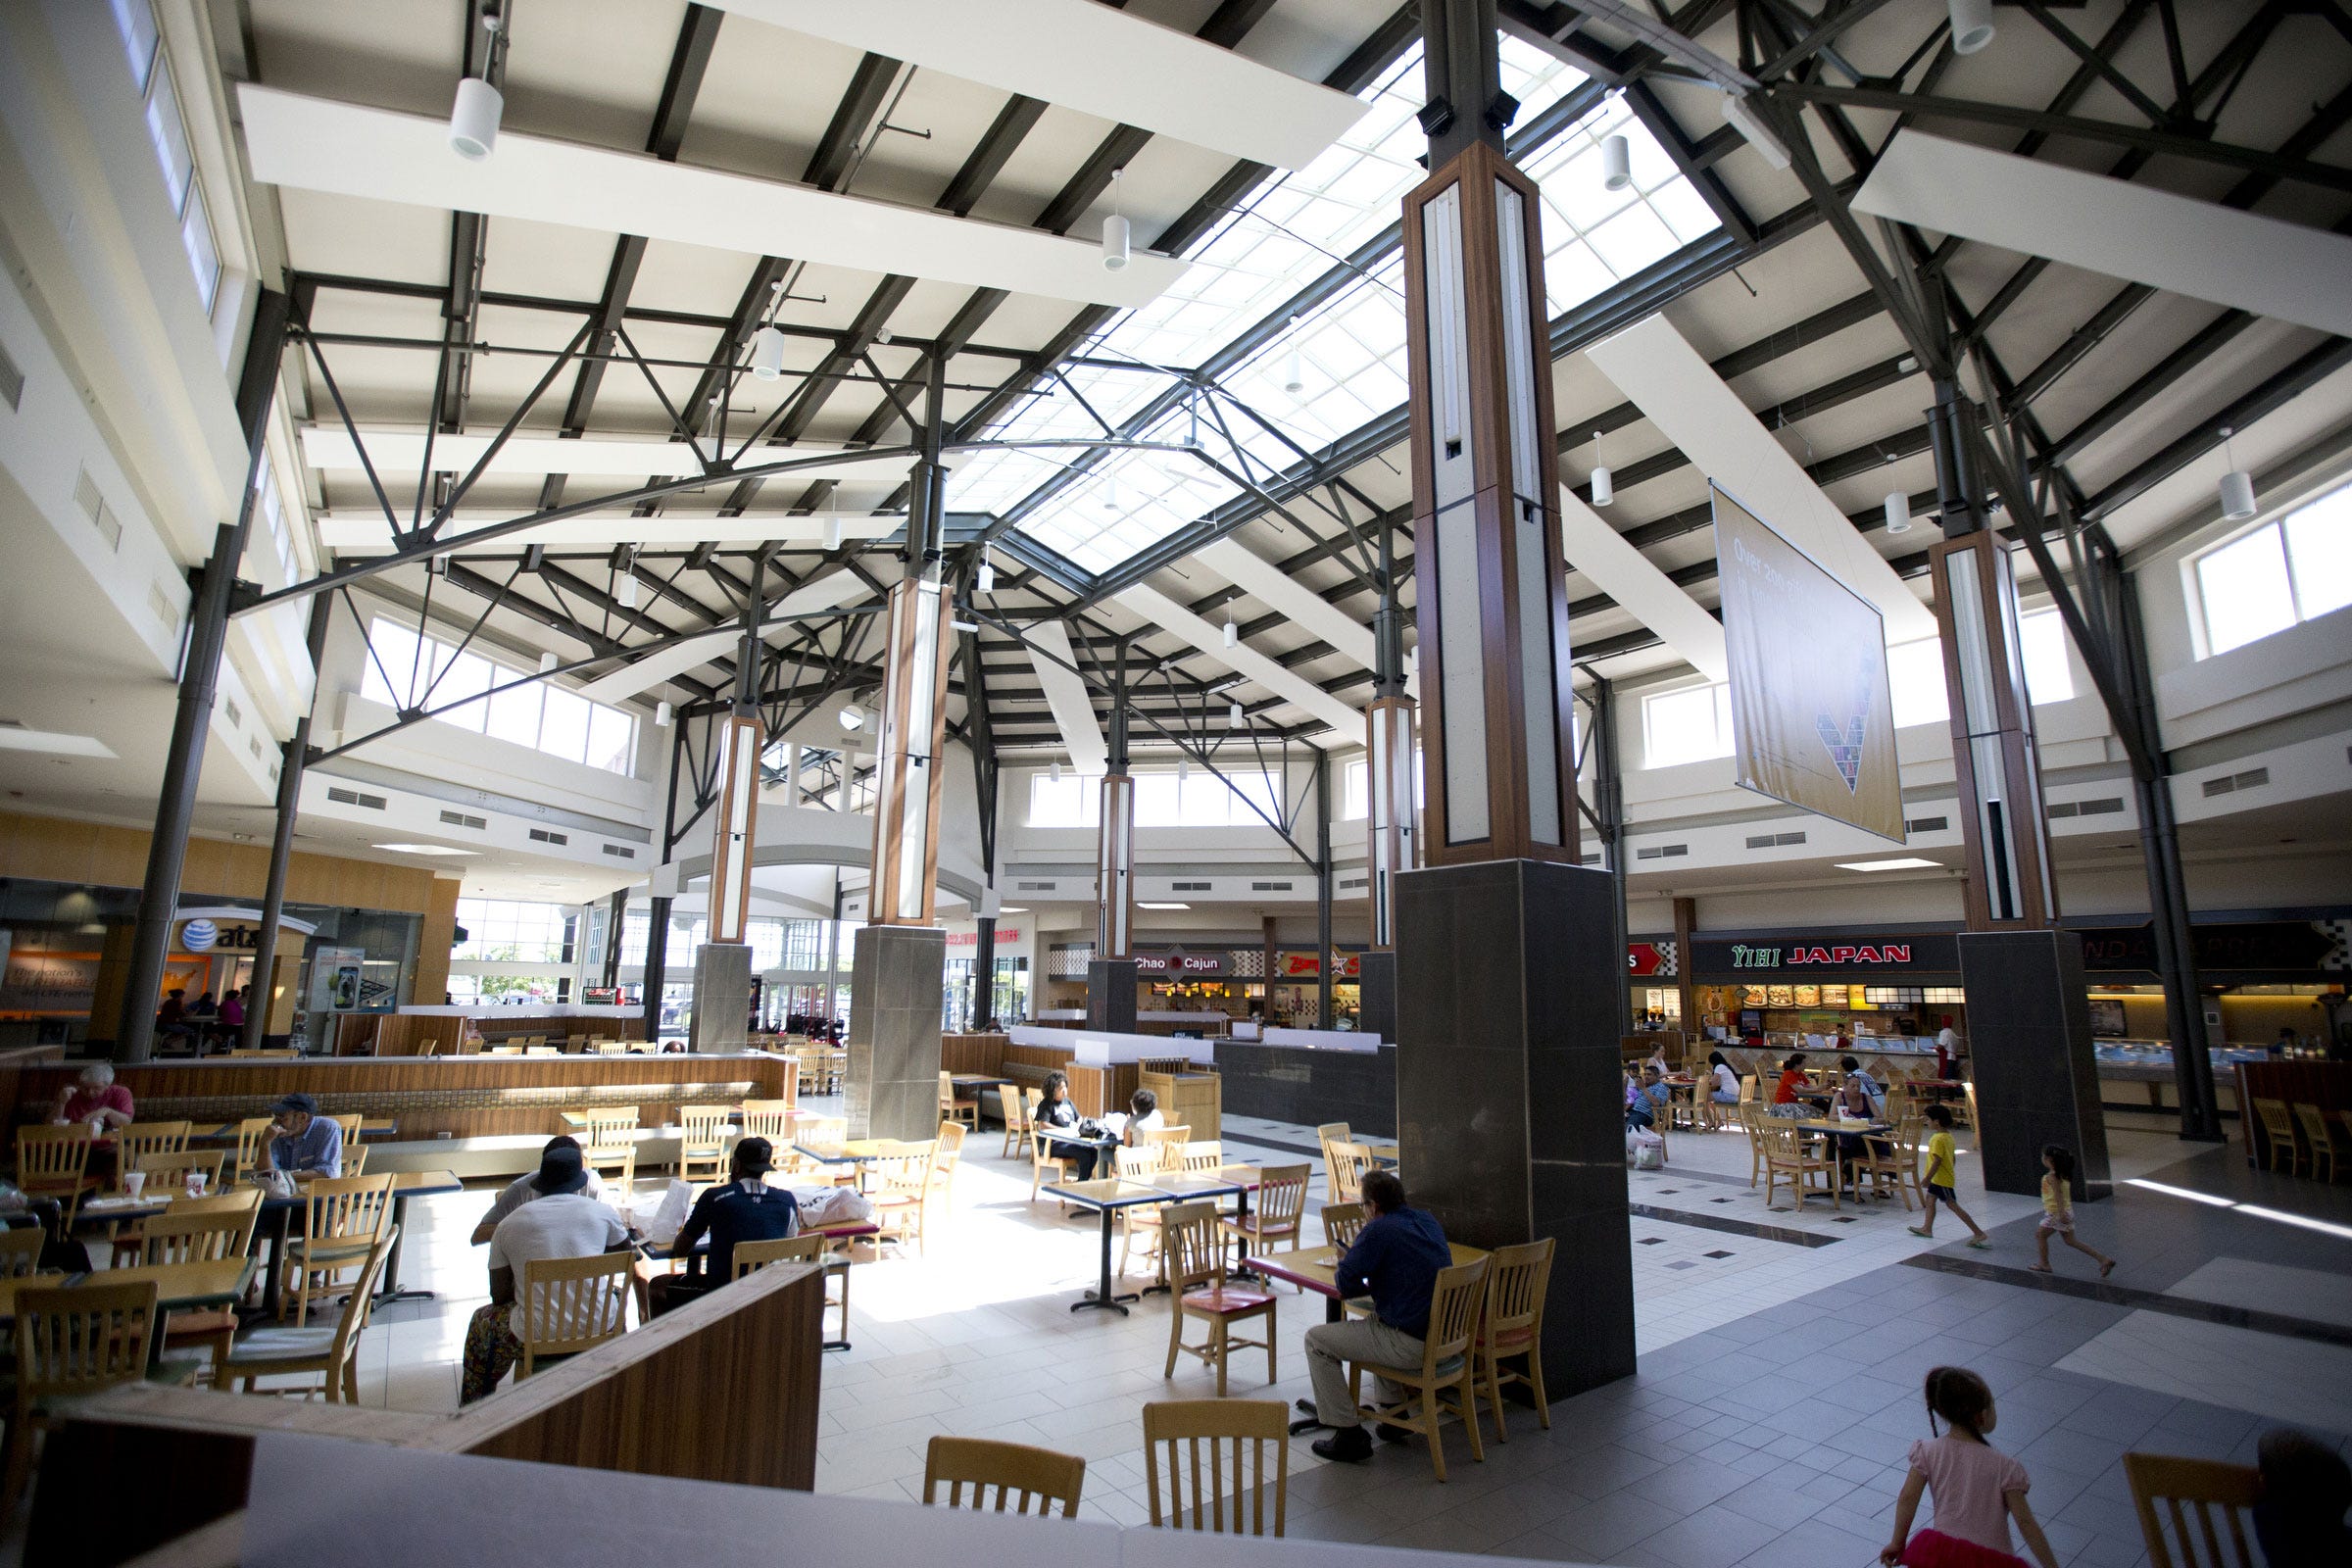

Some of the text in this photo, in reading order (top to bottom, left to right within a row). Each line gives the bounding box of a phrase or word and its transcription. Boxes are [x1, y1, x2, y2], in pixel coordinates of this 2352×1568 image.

[217, 924, 261, 948] at&
[1732, 944, 1911, 968] YIHI JAPAN
[2084, 941, 2148, 959] NDA
[1135, 956, 1218, 971] Chao Cajun
